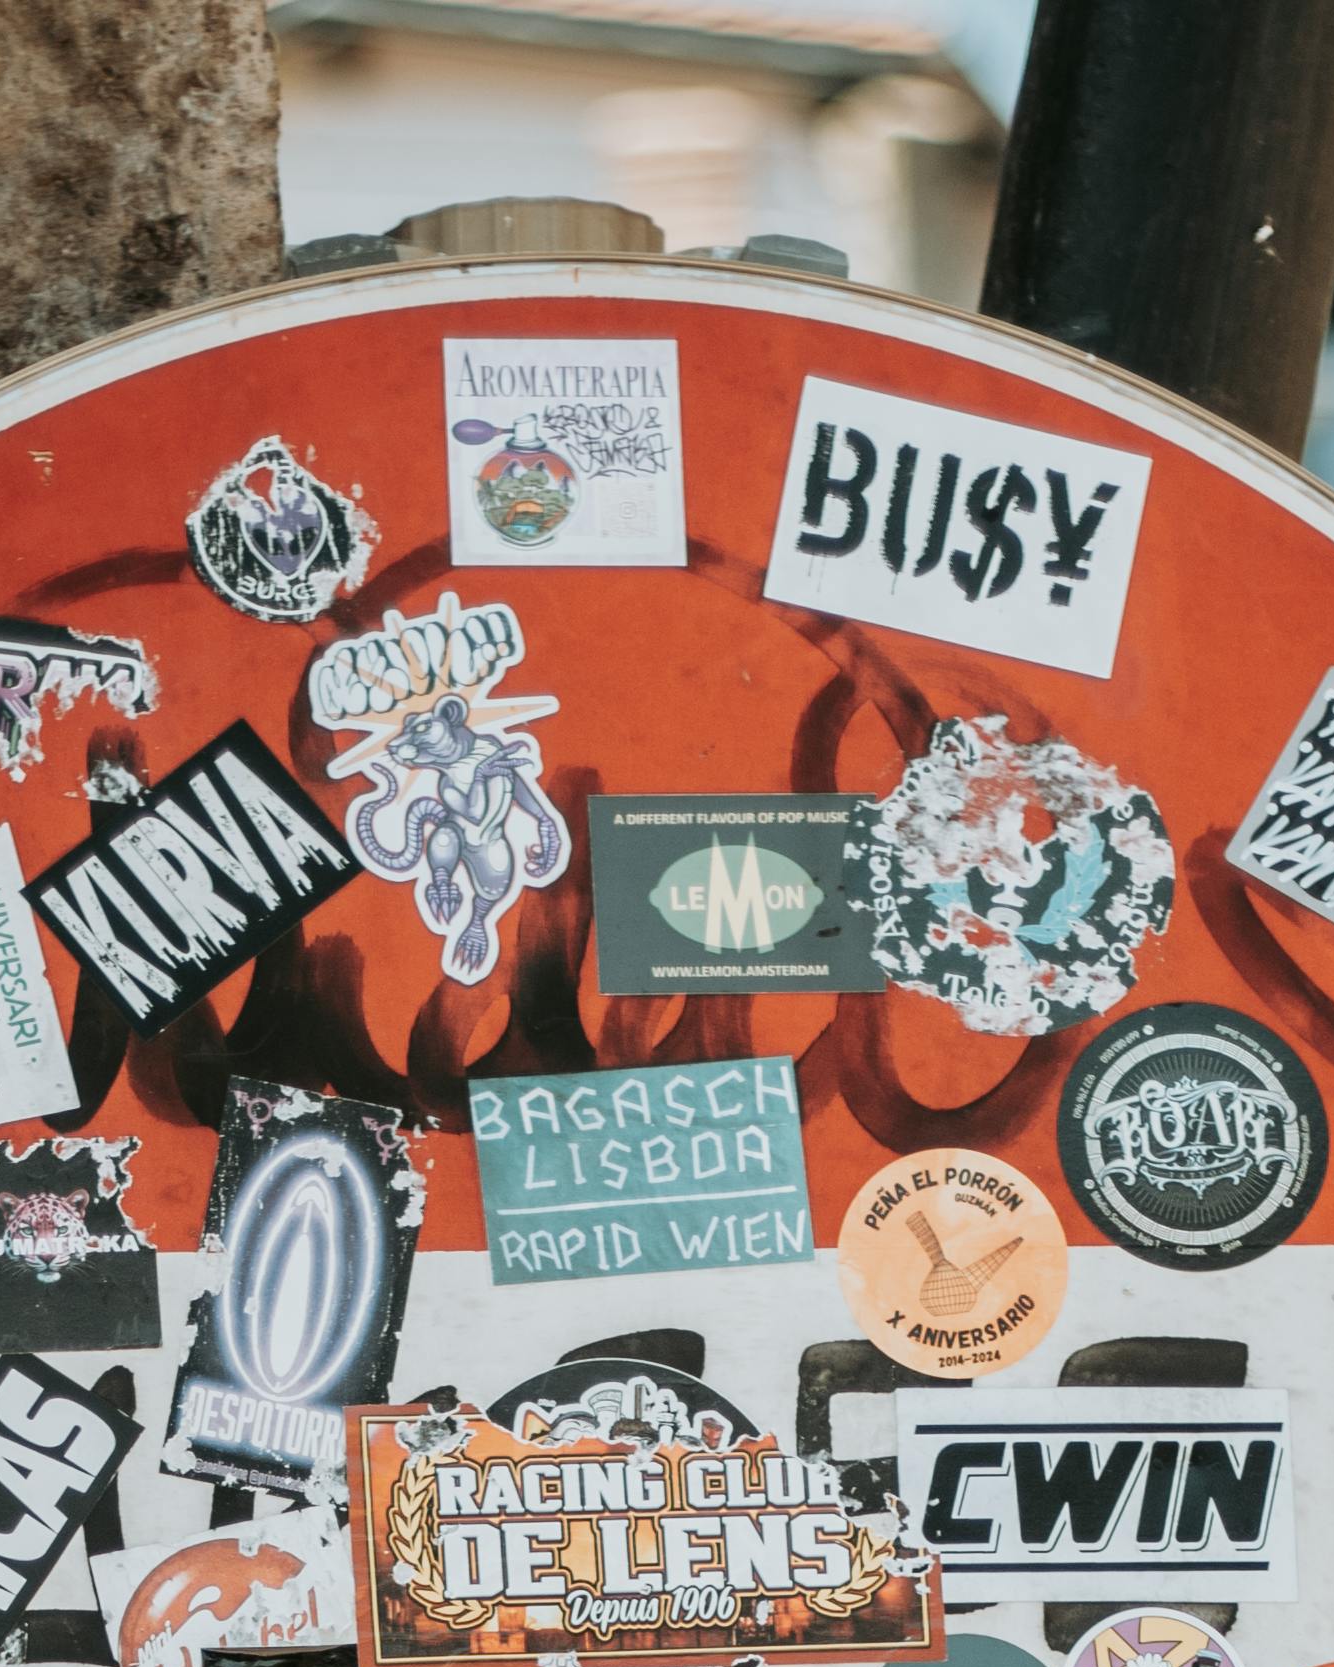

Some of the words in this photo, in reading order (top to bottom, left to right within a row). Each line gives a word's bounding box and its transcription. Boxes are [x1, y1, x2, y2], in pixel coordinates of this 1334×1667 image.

[455, 352, 668, 398] AROMATERAPIA
[614, 814, 625, 824] A
[626, 813, 694, 825] DIFFERENT
[696, 812, 756, 824] FLAVOUR
[758, 812, 776, 824] OF
[778, 812, 805, 824] POP
[807, 812, 849, 823] MUSIC
[40, 746, 351, 1018] KURVA
[651, 965, 829, 978] WWW.LEMON.AMSTERDAM
[470, 1064, 799, 1141] BAGASCH
[524, 1125, 771, 1190] LISBOA
[864, 1183, 911, 1231] PEÑA
[912, 1169, 938, 1192] EL
[945, 1167, 1024, 1213] PORRÓN
[954, 1192, 998, 1217] GUZMÁN
[499, 1222, 643, 1273] RAPID
[668, 1209, 806, 1262] WIEN
[886, 1310, 906, 1329] X
[907, 1294, 1035, 1350] ANIVERSARIO
[185, 1384, 343, 1462] DESPOTORR
[435, 1458, 667, 1518] RACING
[685, 1453, 842, 1510] CLUB
[922, 1440, 1282, 1554] CWIN
[440, 1519, 567, 1601] DE
[600, 1511, 854, 1596] LENS
[568, 1591, 659, 1631] Depuis
[670, 1586, 736, 1622] 1906
